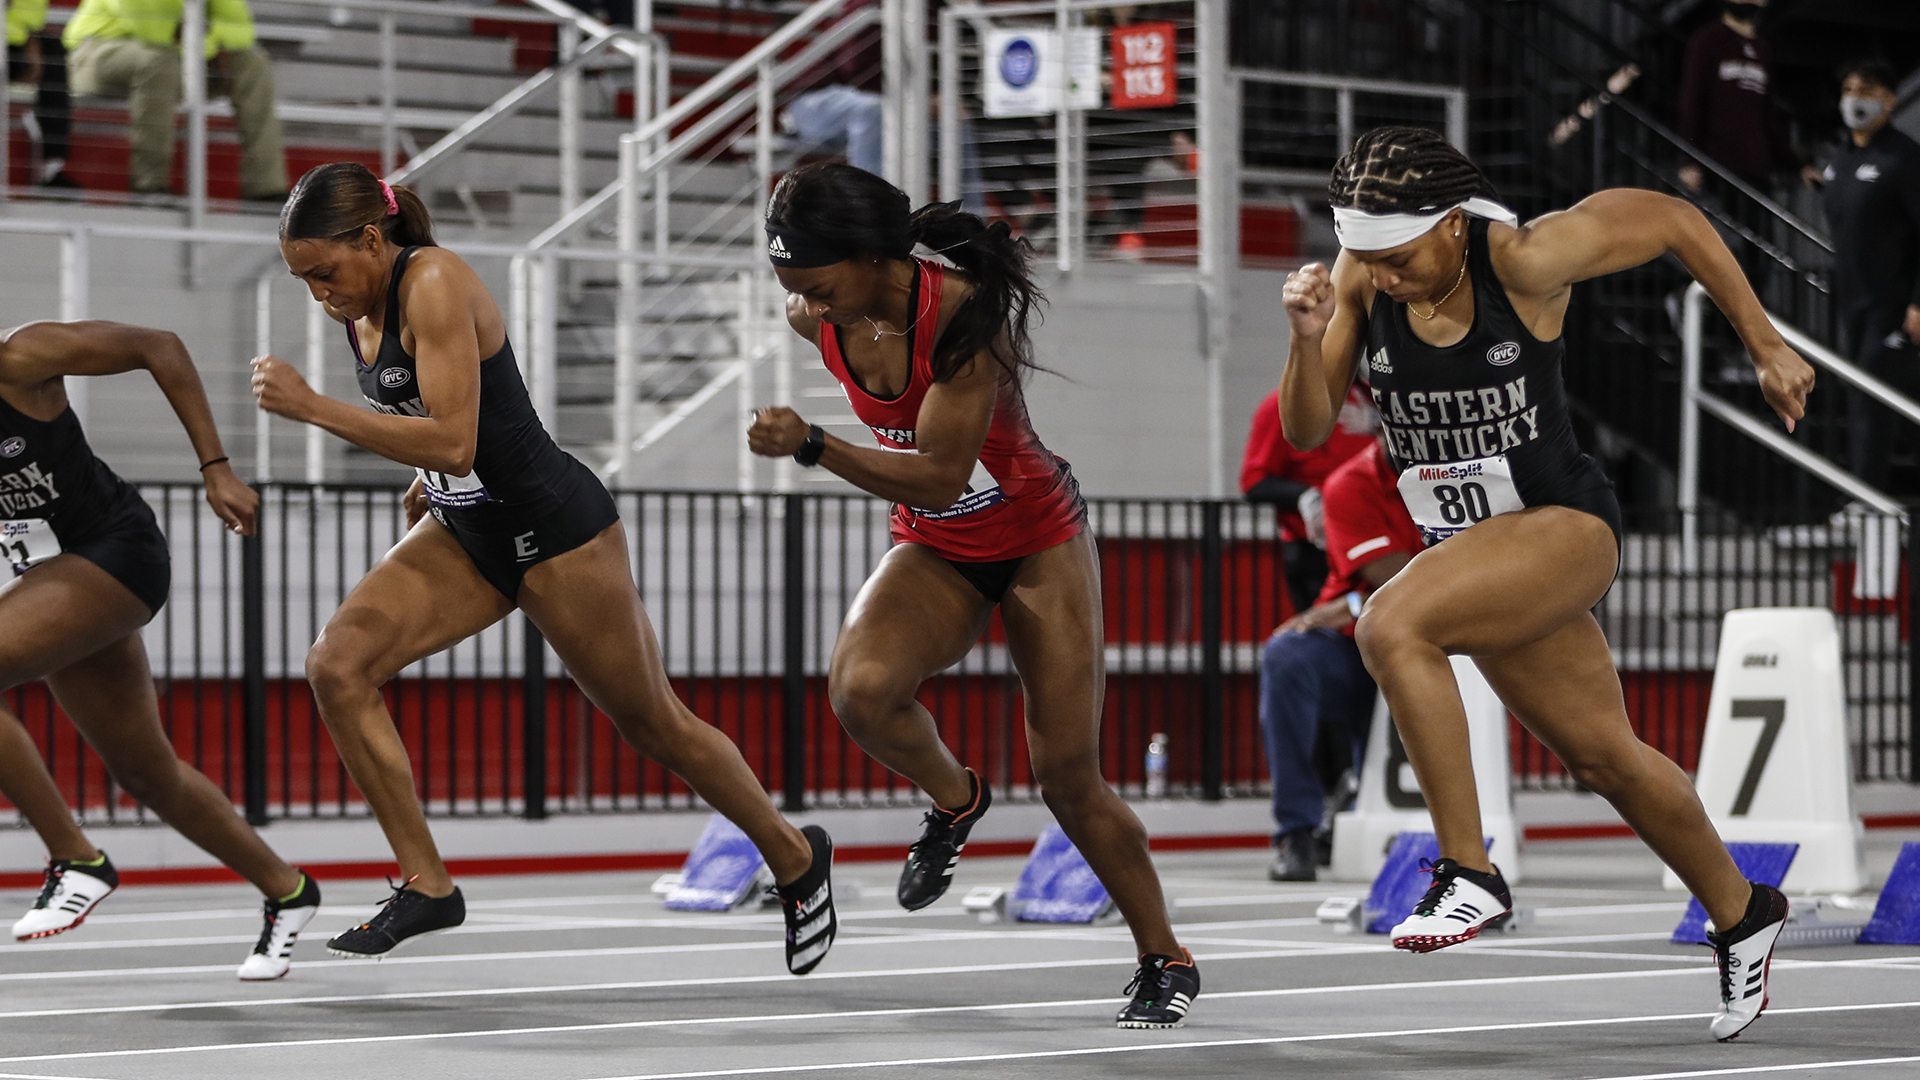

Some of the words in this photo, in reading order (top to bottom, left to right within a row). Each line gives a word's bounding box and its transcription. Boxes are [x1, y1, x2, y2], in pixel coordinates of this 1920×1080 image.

[1122, 33, 1164, 65] 112
[1122, 65, 1165, 99] 113
[1493, 346, 1515, 361] OVC
[384, 372, 403, 383] OVC
[1419, 463, 1484, 481] MileSplit
[1433, 482, 1492, 525] 80
[1729, 698, 1786, 817] 7
